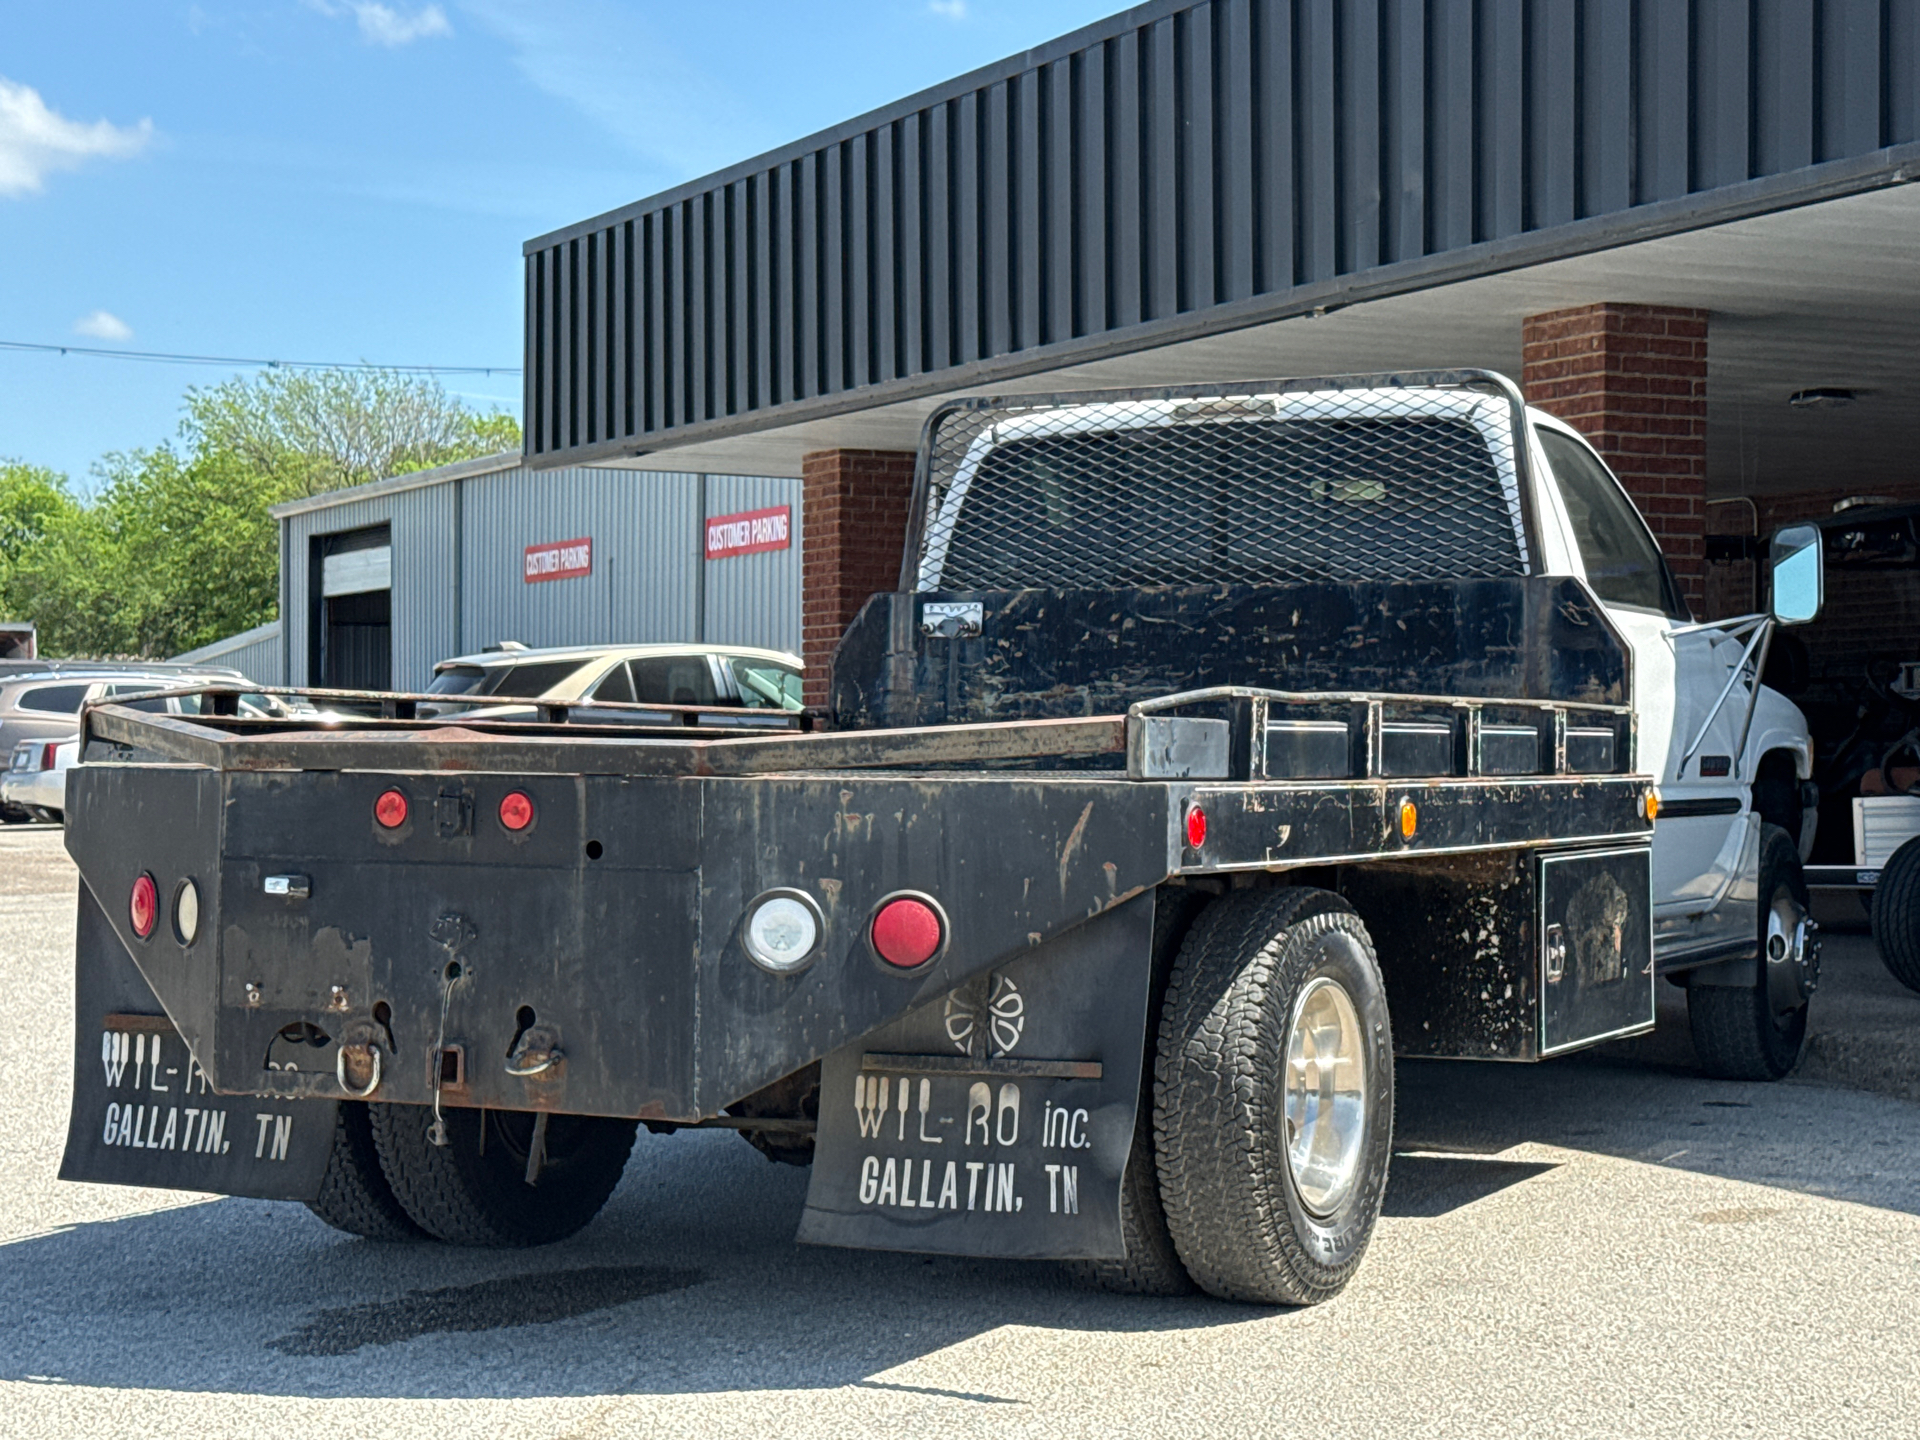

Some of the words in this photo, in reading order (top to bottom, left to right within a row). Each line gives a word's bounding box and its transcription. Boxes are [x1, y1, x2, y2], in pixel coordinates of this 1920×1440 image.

[526, 549, 560, 576] CUSTOMER
[560, 544, 589, 571] PARKING
[708, 520, 750, 552] CUSTOMER
[752, 513, 788, 545] PARKING
[103, 1102, 230, 1154] GALLATIN,
[255, 1113, 292, 1160] TN
[854, 1075, 1021, 1146] WIL-RO
[1042, 1100, 1091, 1148] inc.
[859, 1156, 1023, 1212] GALLATIN,
[1044, 1164, 1079, 1214] TN
